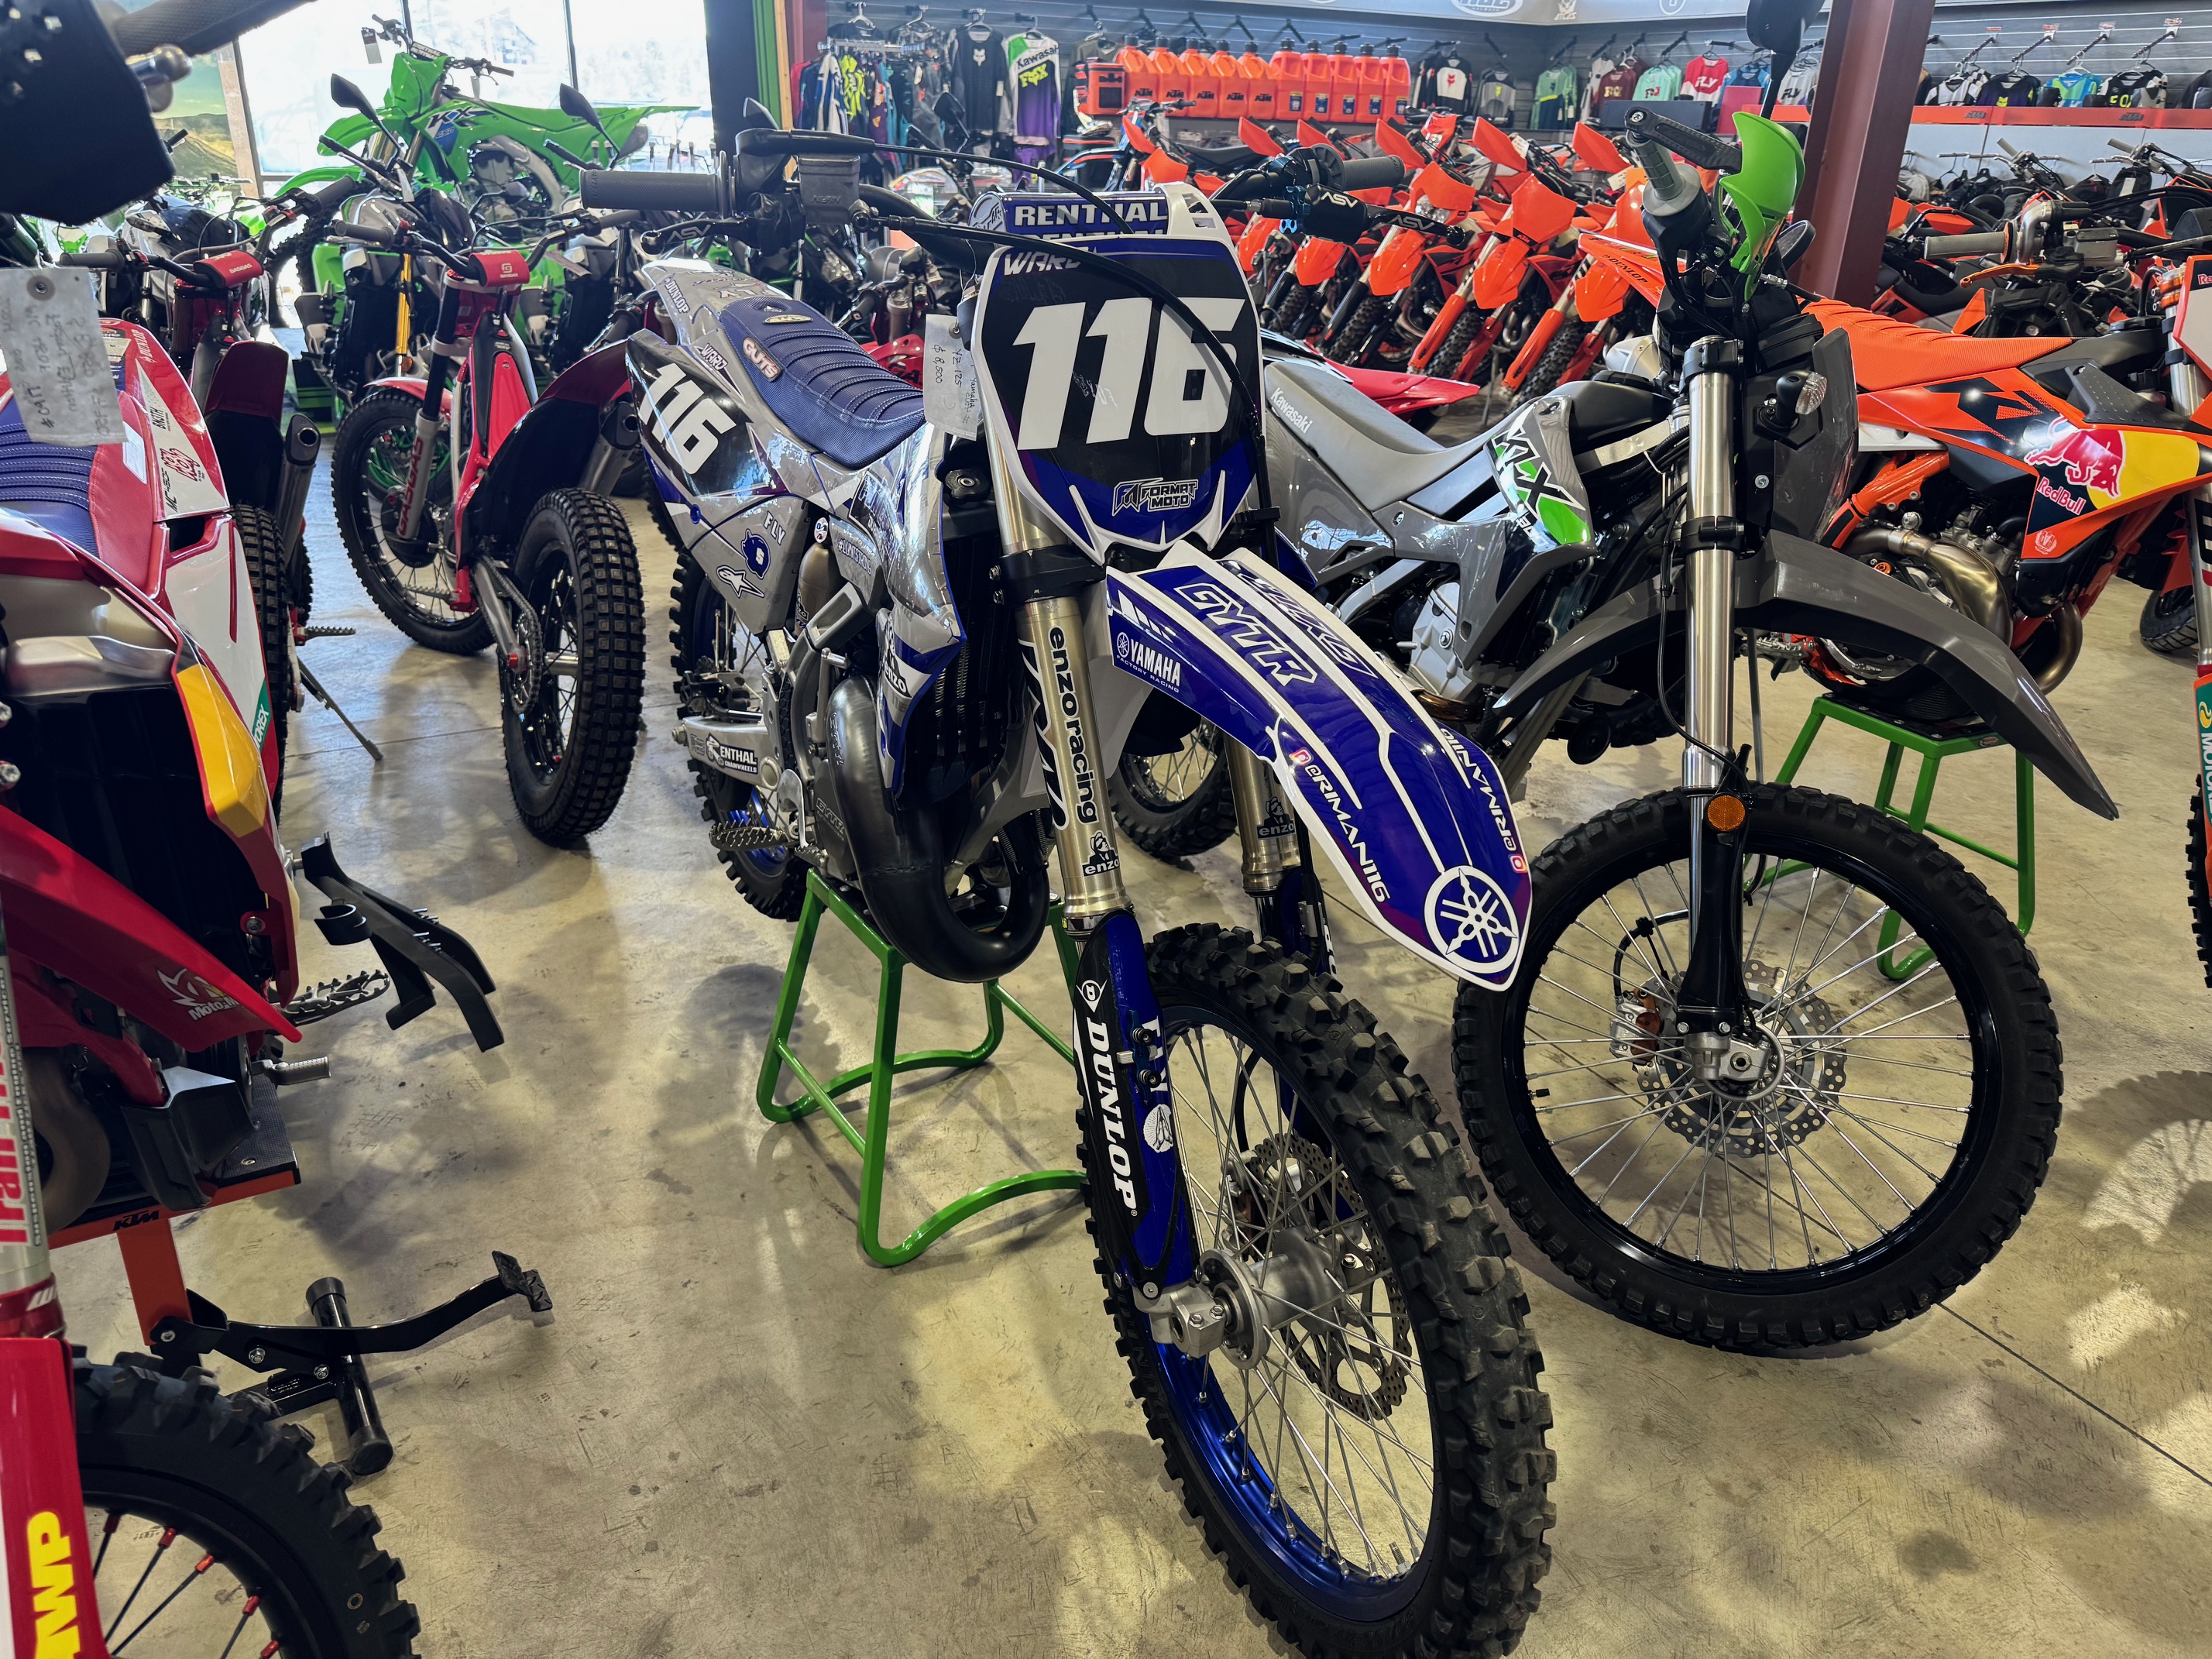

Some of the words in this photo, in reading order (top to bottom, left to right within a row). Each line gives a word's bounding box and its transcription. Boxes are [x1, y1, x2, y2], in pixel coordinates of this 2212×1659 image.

[1135, 88, 1152, 98] KTM
[1166, 90, 1184, 99] KTM
[1197, 91, 1215, 101] KTM
[1226, 92, 1244, 101] KTM
[1255, 94, 1273, 102] KTM
[428, 106, 475, 129] KX
[1321, 191, 1358, 208] ASV
[1014, 201, 1169, 227] RENTHAL
[1389, 215, 1435, 230] ASV
[668, 225, 711, 243] ASV
[1607, 258, 1648, 283] DUNLOP
[664, 280, 691, 314] DUNLOP
[130, 328, 155, 362] DUNLOP
[701, 342, 729, 371] WARD
[952, 349, 963, 365] YZ
[743, 337, 781, 380] GUTS
[953, 370, 963, 389] 125
[1012, 297, 1245, 451] 116
[639, 362, 737, 475] 116
[1270, 386, 1314, 434] Kawasaki
[397, 436, 424, 537] GASGAS
[1141, 482, 1197, 497] FORMAT
[1149, 496, 1191, 509] MOTO
[763, 510, 786, 546] FLY
[1173, 582, 1317, 688] GYTR
[1116, 654, 1147, 675] FACTORY
[1149, 674, 1180, 693] RACING
[1130, 638, 1181, 687] YAMAHA
[706, 733, 757, 766] RENTHAL
[723, 760, 757, 774] CHAINWHEELS
[1258, 822, 1295, 837] enzo
[1304, 764, 1391, 902] @RIMAN116
[1084, 858, 1118, 875] enzo
[1086, 1016, 1137, 1210] DUNLOP
[112, 1209, 160, 1231] KTM
